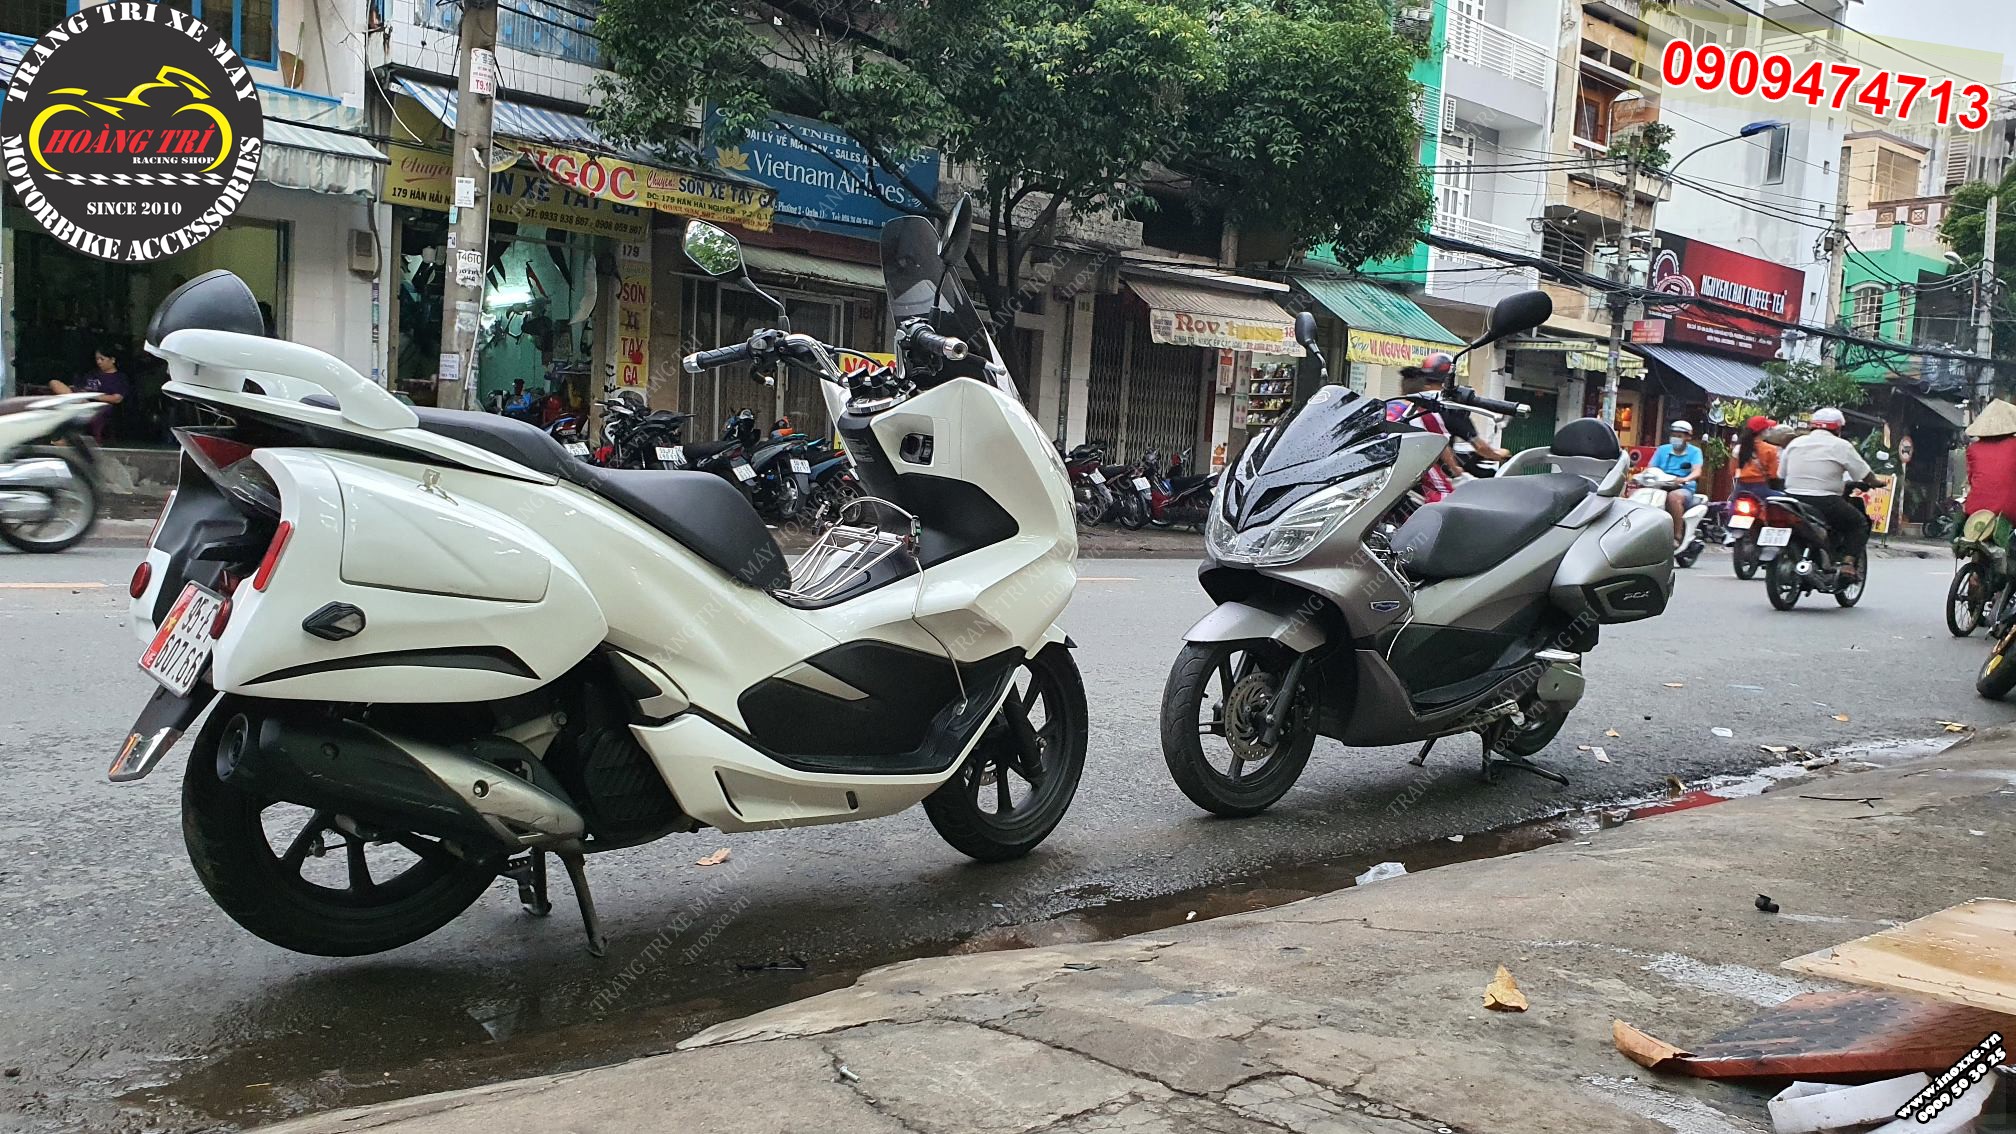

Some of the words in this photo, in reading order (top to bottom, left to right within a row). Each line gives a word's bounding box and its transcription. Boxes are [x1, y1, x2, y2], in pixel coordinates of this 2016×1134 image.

[835, 149, 861, 163] SALES
[753, 149, 835, 190] Vietnam
[391, 187, 408, 199] 179
[409, 187, 427, 201] HÀN
[710, 182, 726, 201] XE
[622, 244, 640, 258] 179
[623, 365, 639, 385] GA
[154, 634, 204, 688] 607.66
